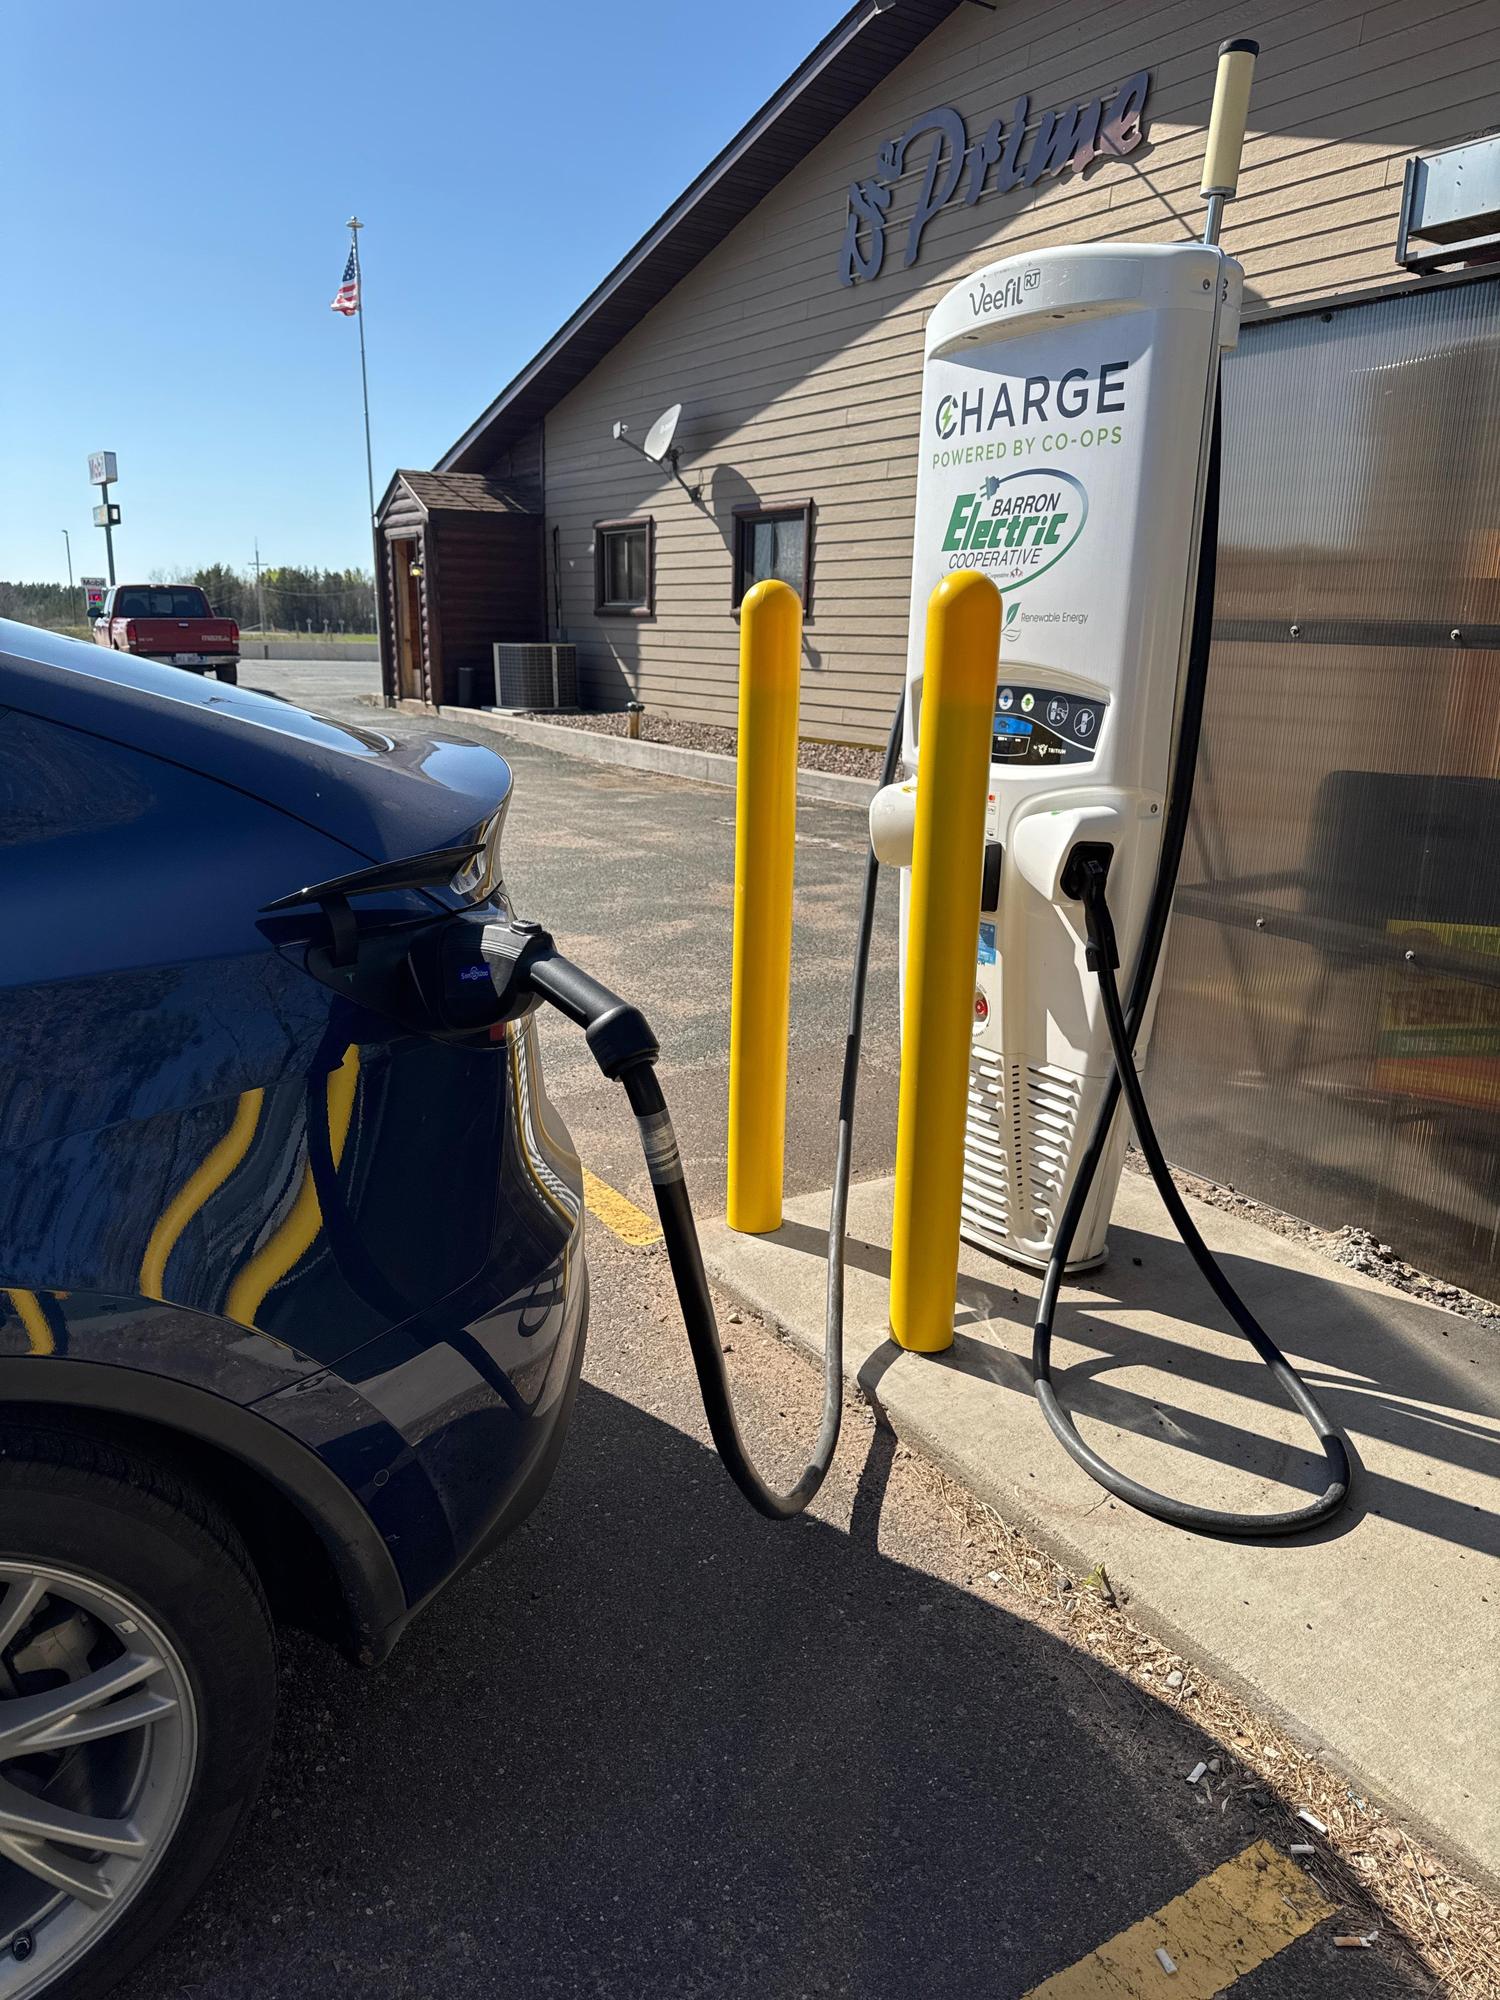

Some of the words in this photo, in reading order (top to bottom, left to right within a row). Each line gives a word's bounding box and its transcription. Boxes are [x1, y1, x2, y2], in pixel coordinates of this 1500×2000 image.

[876, 71, 1150, 268] Prime
[969, 276, 1023, 316] Veefil
[1025, 271, 1041, 288] RT
[935, 360, 1130, 440] CHARGE
[932, 442, 1007, 470] POWERED
[1013, 437, 1036, 456] BY
[1042, 425, 1123, 453] CO-OPS
[941, 493, 1069, 552] Electric
[991, 492, 1061, 518] BARRON
[948, 547, 1043, 569] COOPERATIVE
[82, 578, 105, 587] Mobil
[1020, 612, 1060, 623] Renewable
[1062, 611, 1088, 625] Energy
